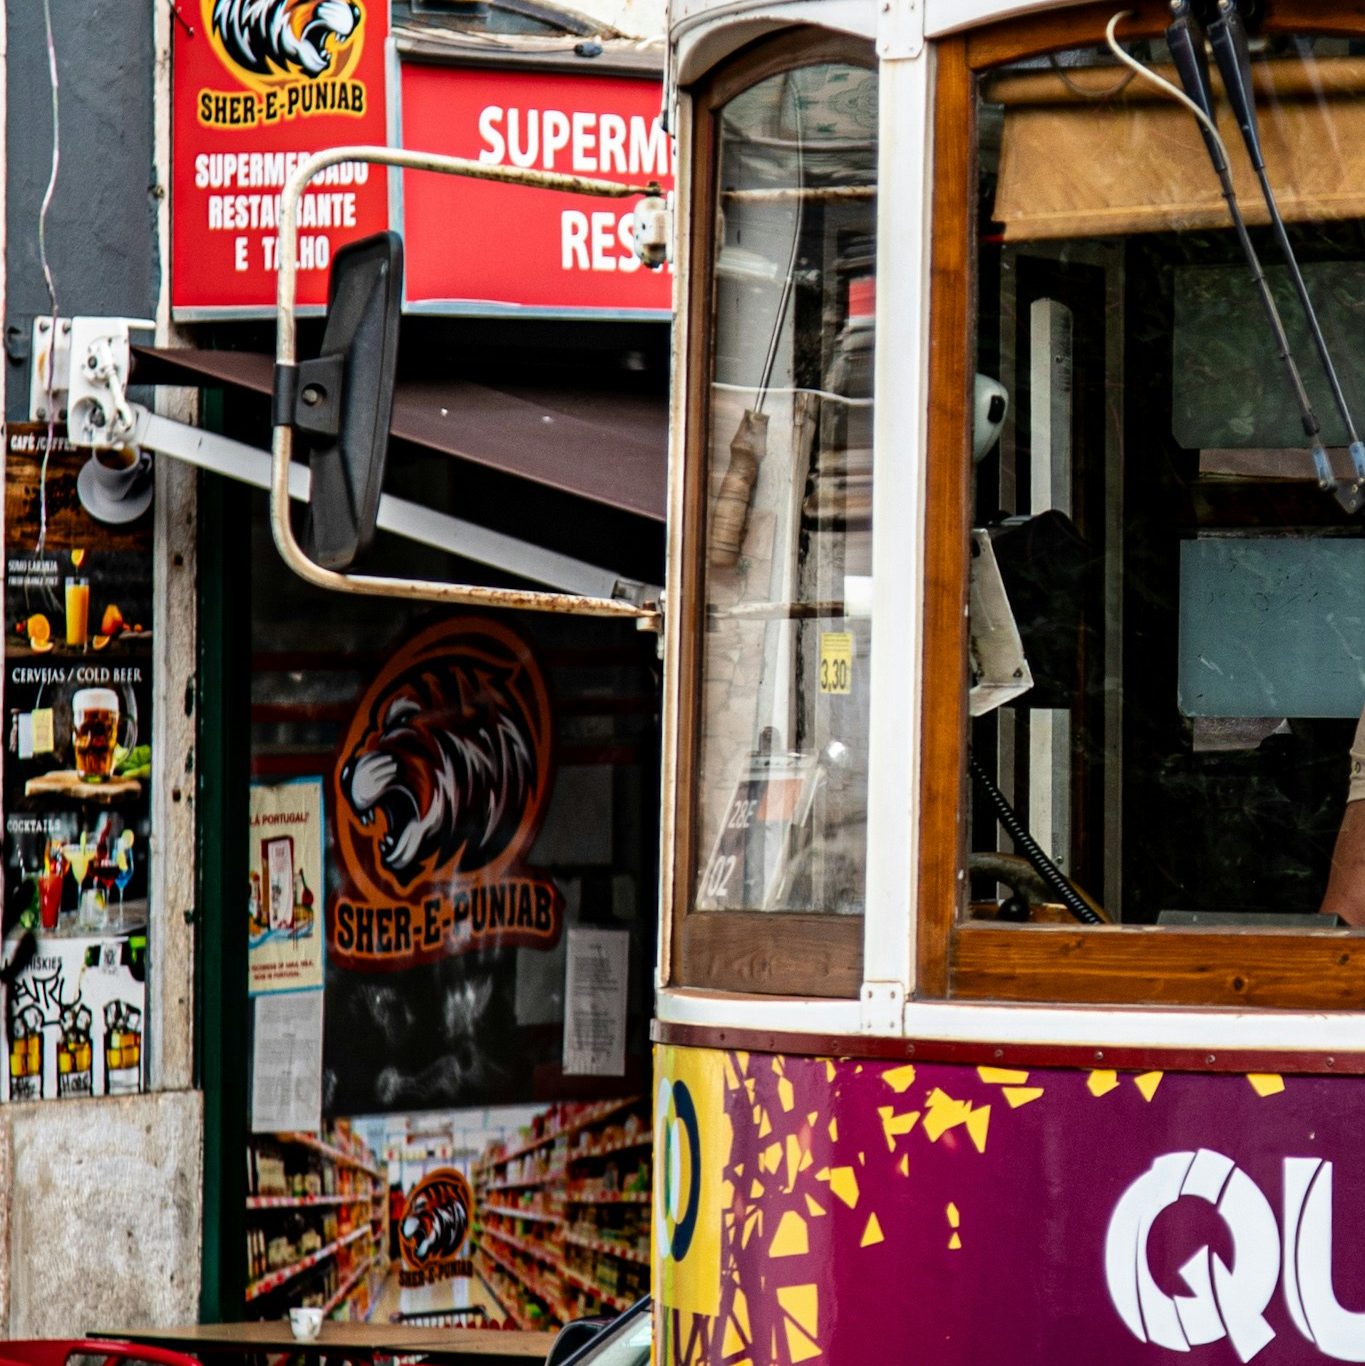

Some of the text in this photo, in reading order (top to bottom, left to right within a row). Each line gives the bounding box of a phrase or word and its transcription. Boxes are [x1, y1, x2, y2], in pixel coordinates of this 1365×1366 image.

[200, 80, 364, 125] SHER-E-PUNJAB
[478, 105, 677, 176] SUPERM
[235, 237, 248, 271] E
[10, 432, 35, 451] CAFÉ
[12, 667, 65, 685] CERVEJAS
[76, 667, 110, 683] COLD
[113, 667, 142, 683] BEER
[7, 817, 61, 833] COCKTAILS
[337, 882, 553, 954] SHER-E-PUNJAB
